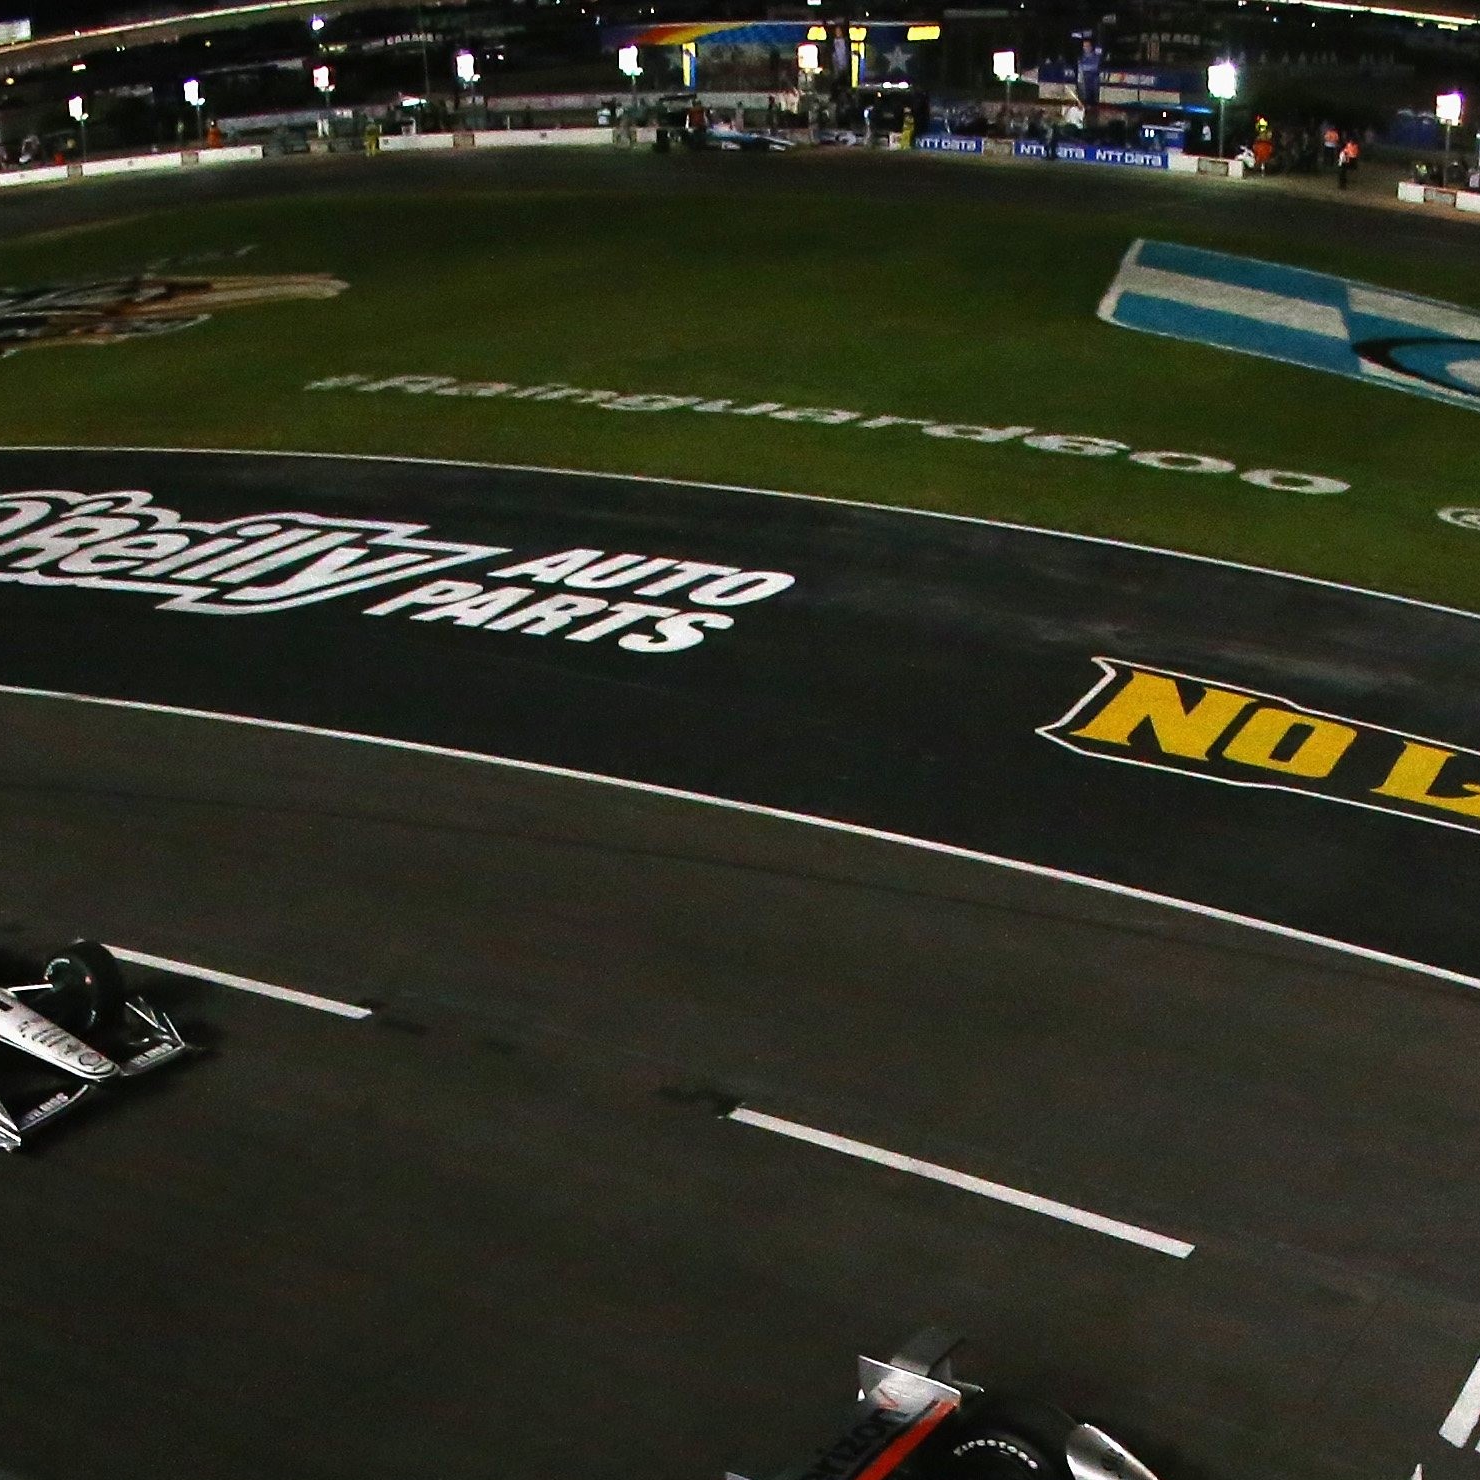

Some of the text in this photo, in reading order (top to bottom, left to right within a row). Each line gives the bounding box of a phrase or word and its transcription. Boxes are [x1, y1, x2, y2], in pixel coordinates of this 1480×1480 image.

[1095, 149, 1123, 162] NTT
[486, 548, 796, 606] AUTO
[364, 578, 735, 653] PARTS
[1071, 668, 1359, 780] NO
[953, 1437, 1039, 1470] Firestone
